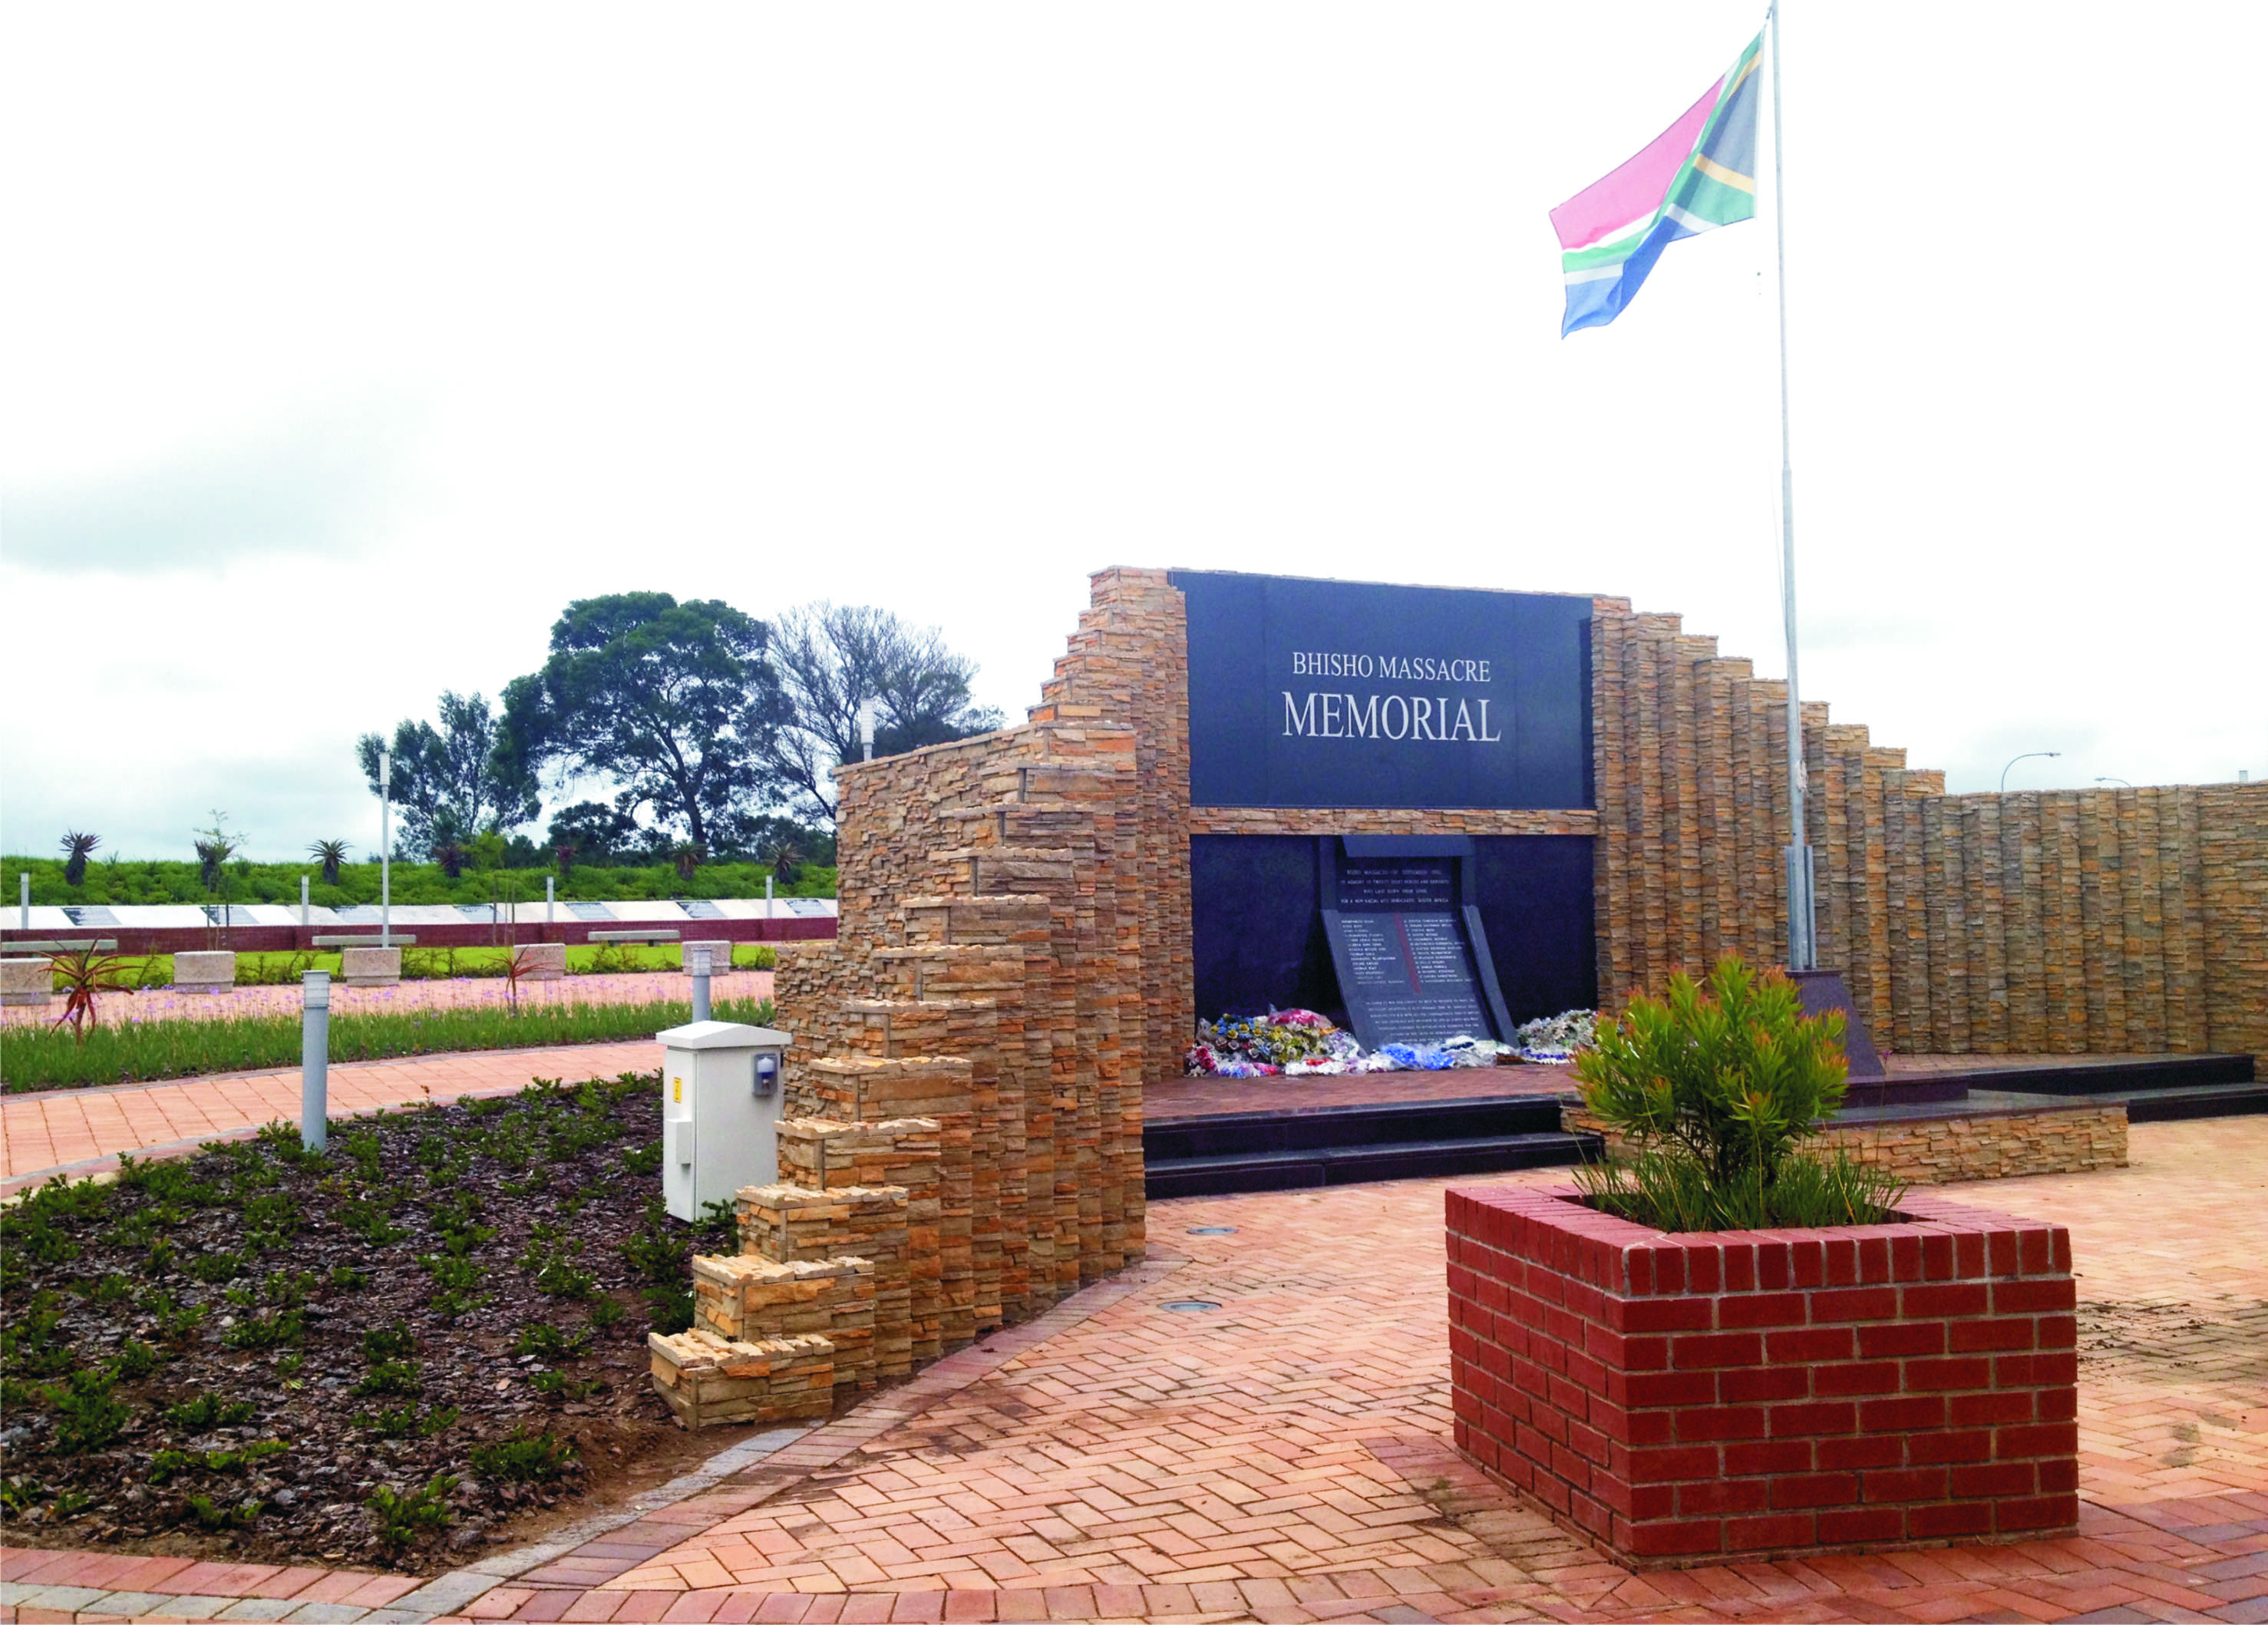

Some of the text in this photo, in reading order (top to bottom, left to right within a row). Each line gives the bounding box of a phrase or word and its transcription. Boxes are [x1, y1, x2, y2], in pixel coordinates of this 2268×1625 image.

[1292, 652, 1491, 682] BHISHO MASSACRE
[1281, 691, 1502, 742] MEMORIAL
